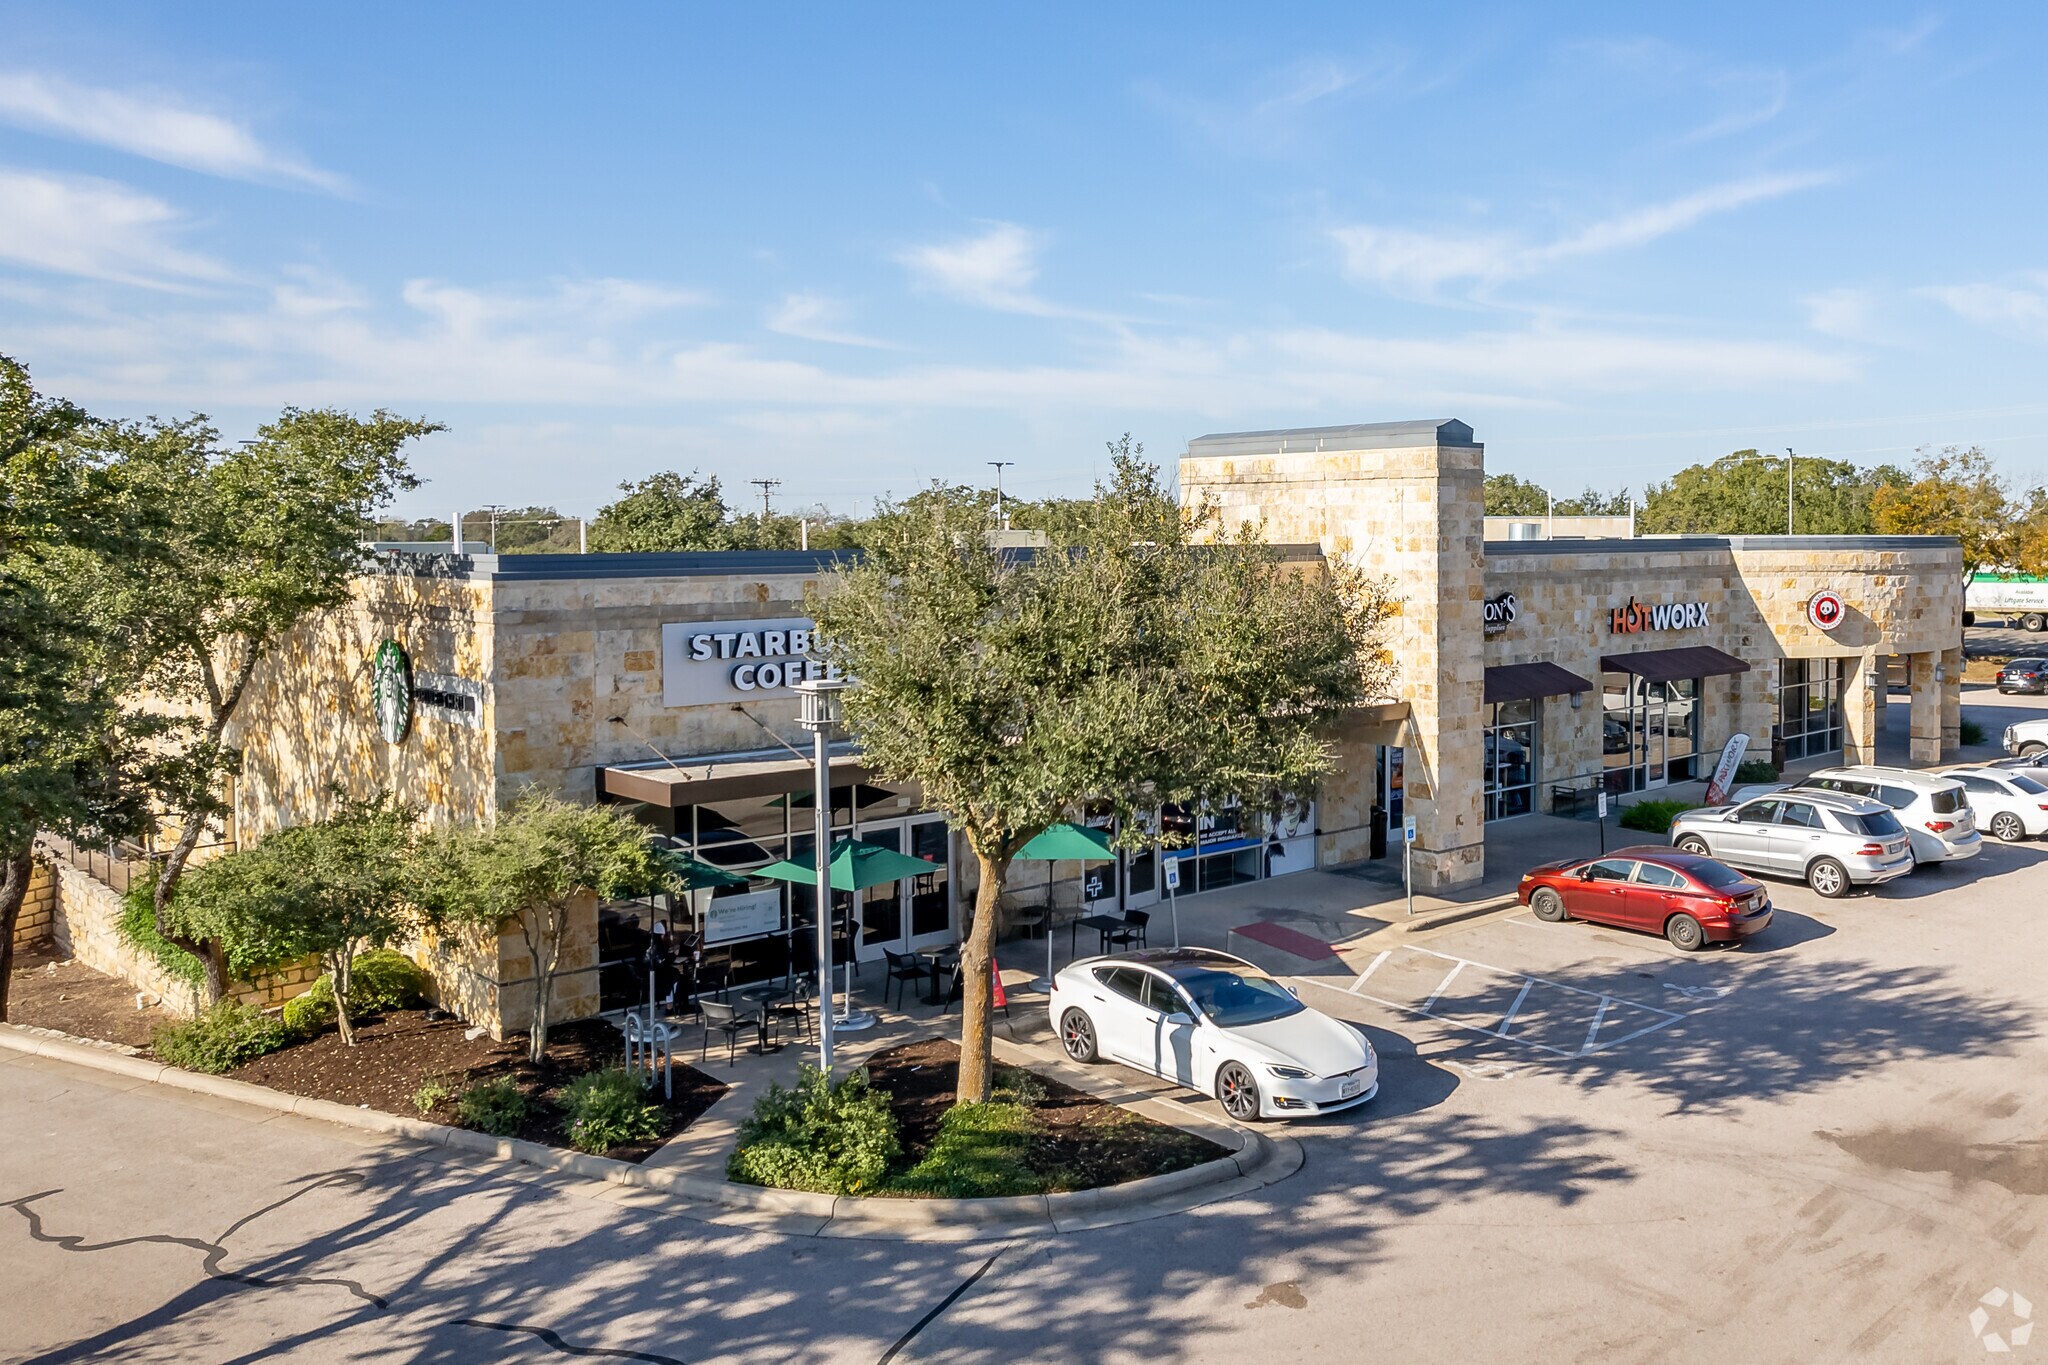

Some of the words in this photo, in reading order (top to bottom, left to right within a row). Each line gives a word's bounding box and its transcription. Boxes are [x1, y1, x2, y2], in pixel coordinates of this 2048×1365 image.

[1611, 596, 1709, 634] HOTWORX
[689, 628, 848, 661] STARBU
[730, 661, 857, 691] COFFE
[1199, 815, 1215, 831] IN
[1208, 829, 1227, 838] ACCEPT
[1217, 831, 1247, 842] INSURANC
